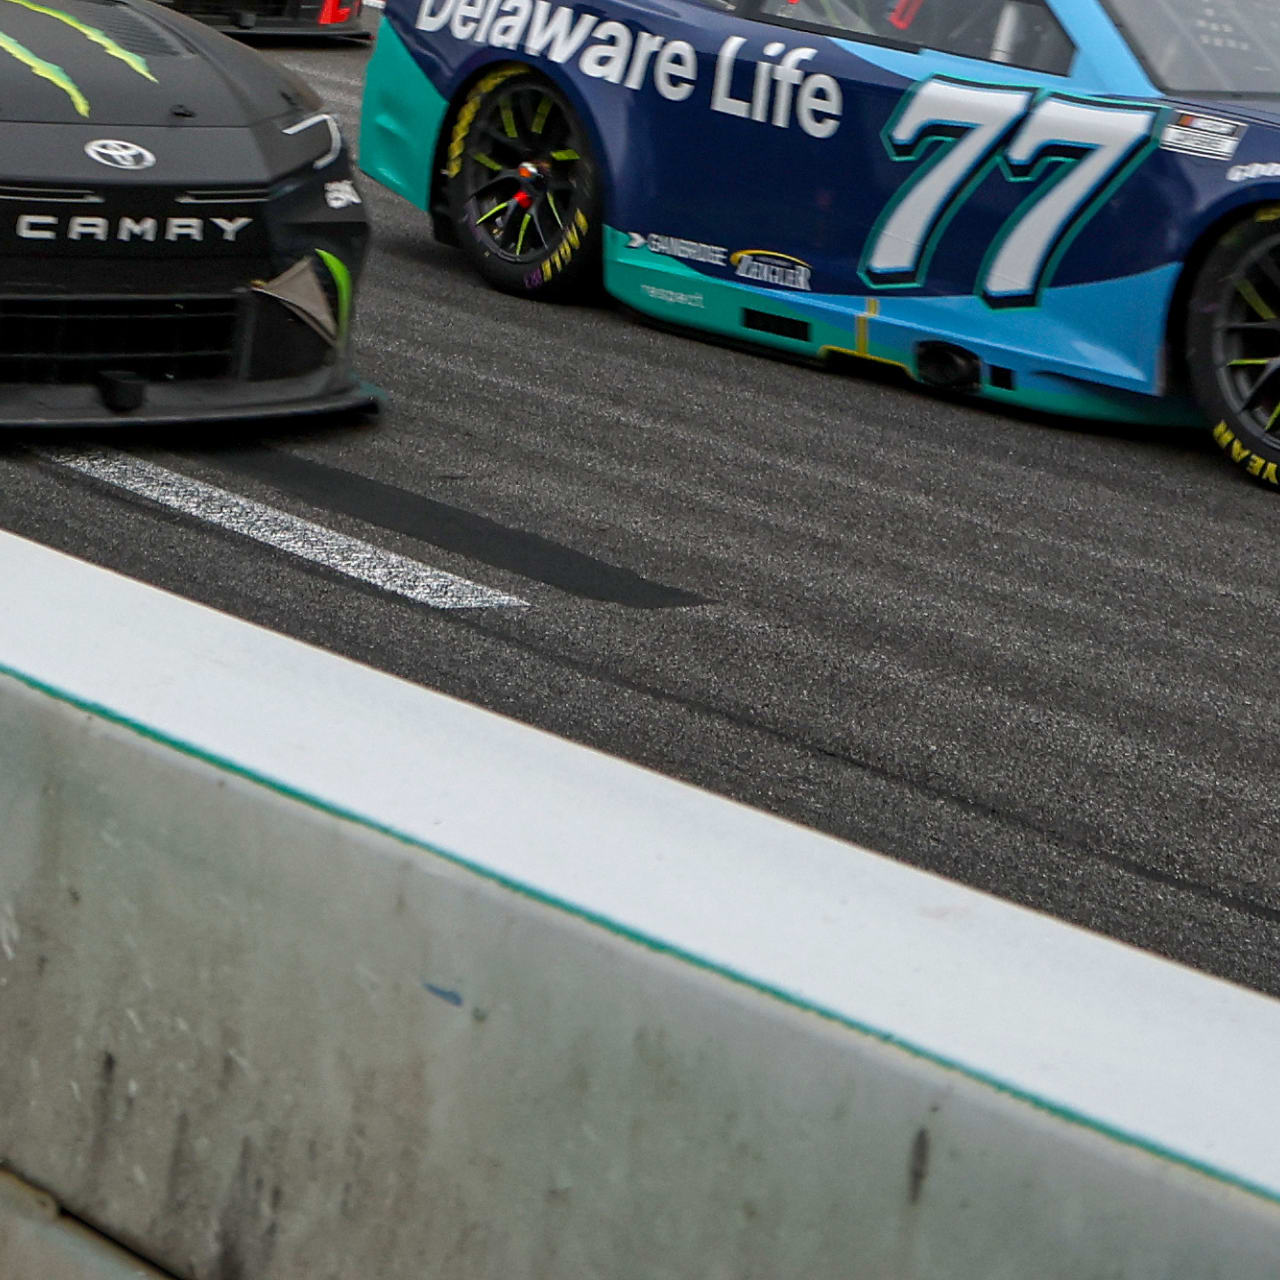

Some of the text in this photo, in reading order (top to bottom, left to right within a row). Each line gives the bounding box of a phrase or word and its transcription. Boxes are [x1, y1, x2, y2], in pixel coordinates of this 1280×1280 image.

[710, 35, 845, 140] Life
[15, 215, 254, 243] CAMRY
[857, 73, 1162, 311] 77
